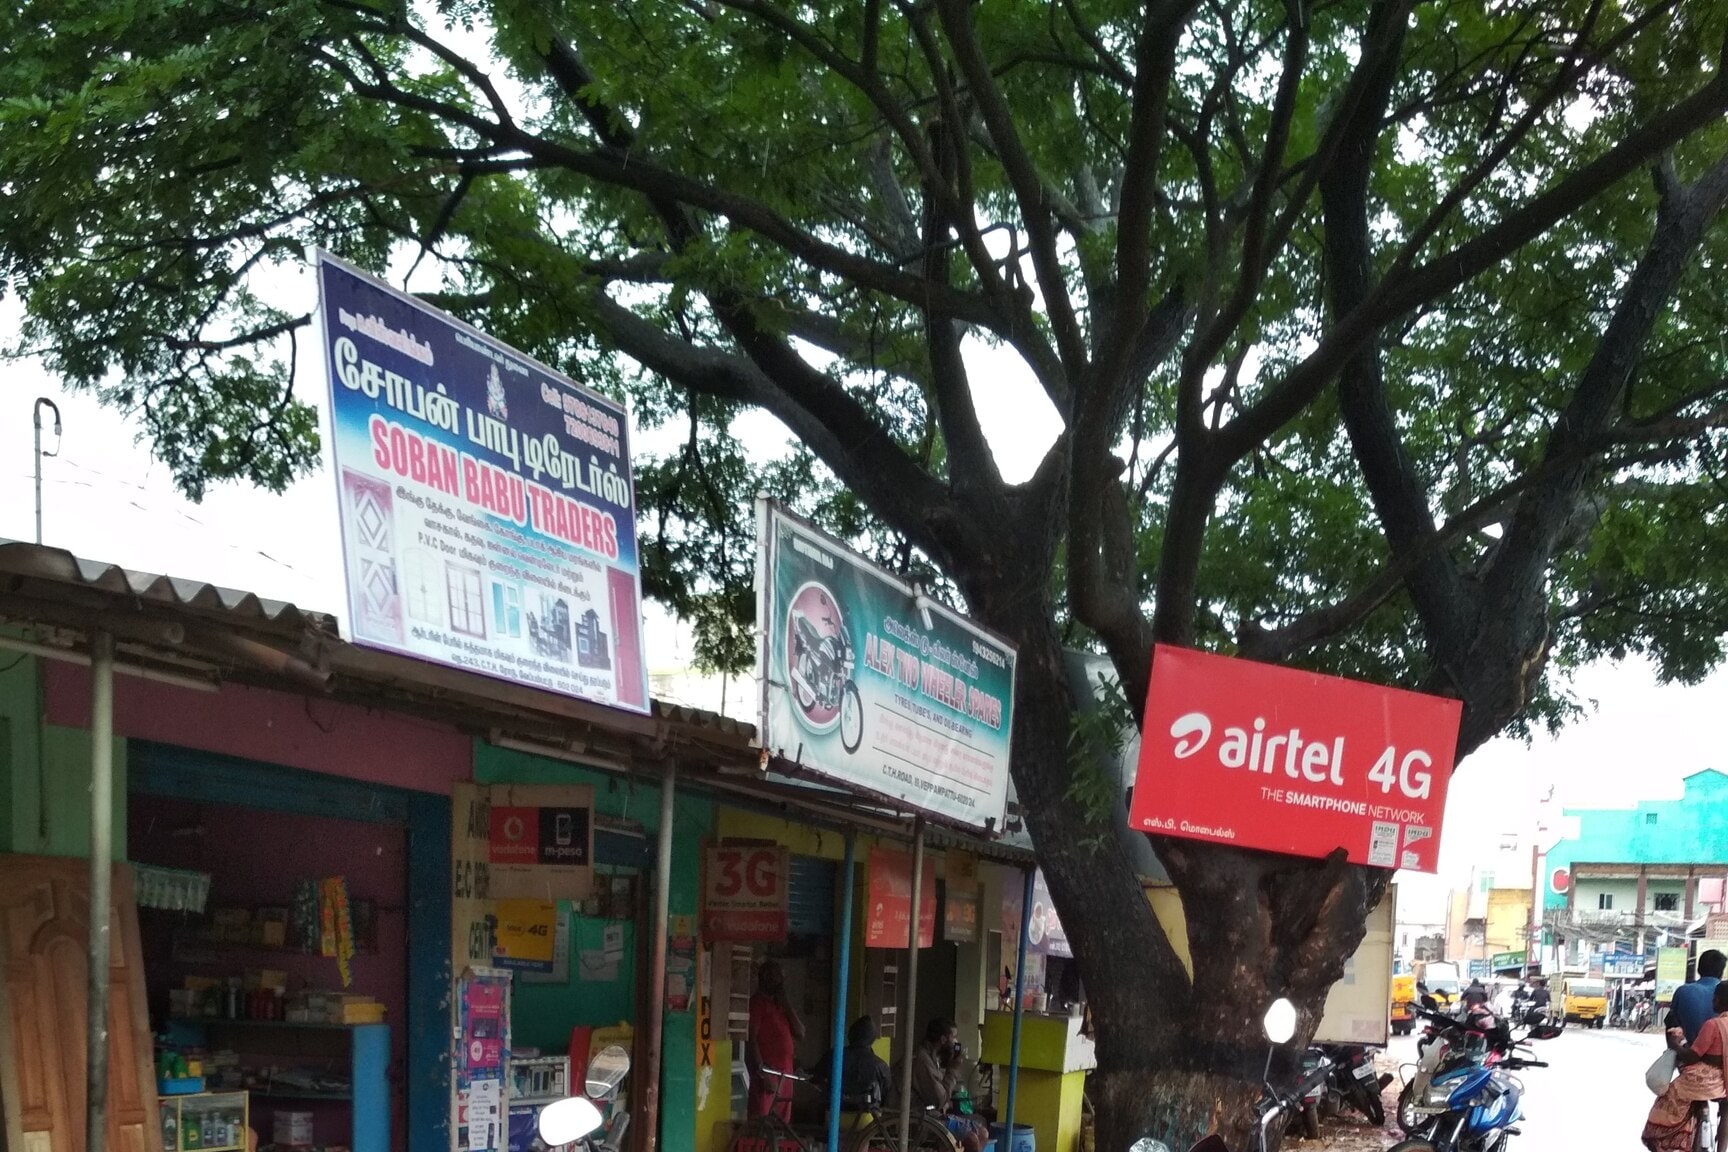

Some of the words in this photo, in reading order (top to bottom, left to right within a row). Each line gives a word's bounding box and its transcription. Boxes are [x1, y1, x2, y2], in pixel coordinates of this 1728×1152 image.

[334, 336, 459, 435] சோபன்
[465, 407, 522, 469] பாபு
[522, 431, 629, 509] டிரேடர்ஸ்
[371, 416, 459, 499] SOBAN
[464, 459, 526, 524] BABU
[527, 483, 618, 559] TRADERS
[440, 540, 456, 555] Door
[864, 632, 895, 679] ALEX
[896, 647, 920, 691] TWO
[921, 661, 966, 714] WHEELER
[968, 685, 1002, 731] SPARES
[933, 711, 945, 725] AND
[1219, 717, 1345, 786] airtel
[1368, 746, 1433, 800] 4G
[1260, 787, 1284, 802] THE
[1285, 791, 1366, 815] SMARTPHONE
[1367, 804, 1425, 825] NETWORK
[1143, 817, 1176, 831] எஸ்.பி.
[1180, 820, 1235, 839] மொபைல்ஸ்
[544, 846, 584, 860] m-pesa
[715, 851, 777, 897] 3G
[527, 923, 548, 937] 4G
